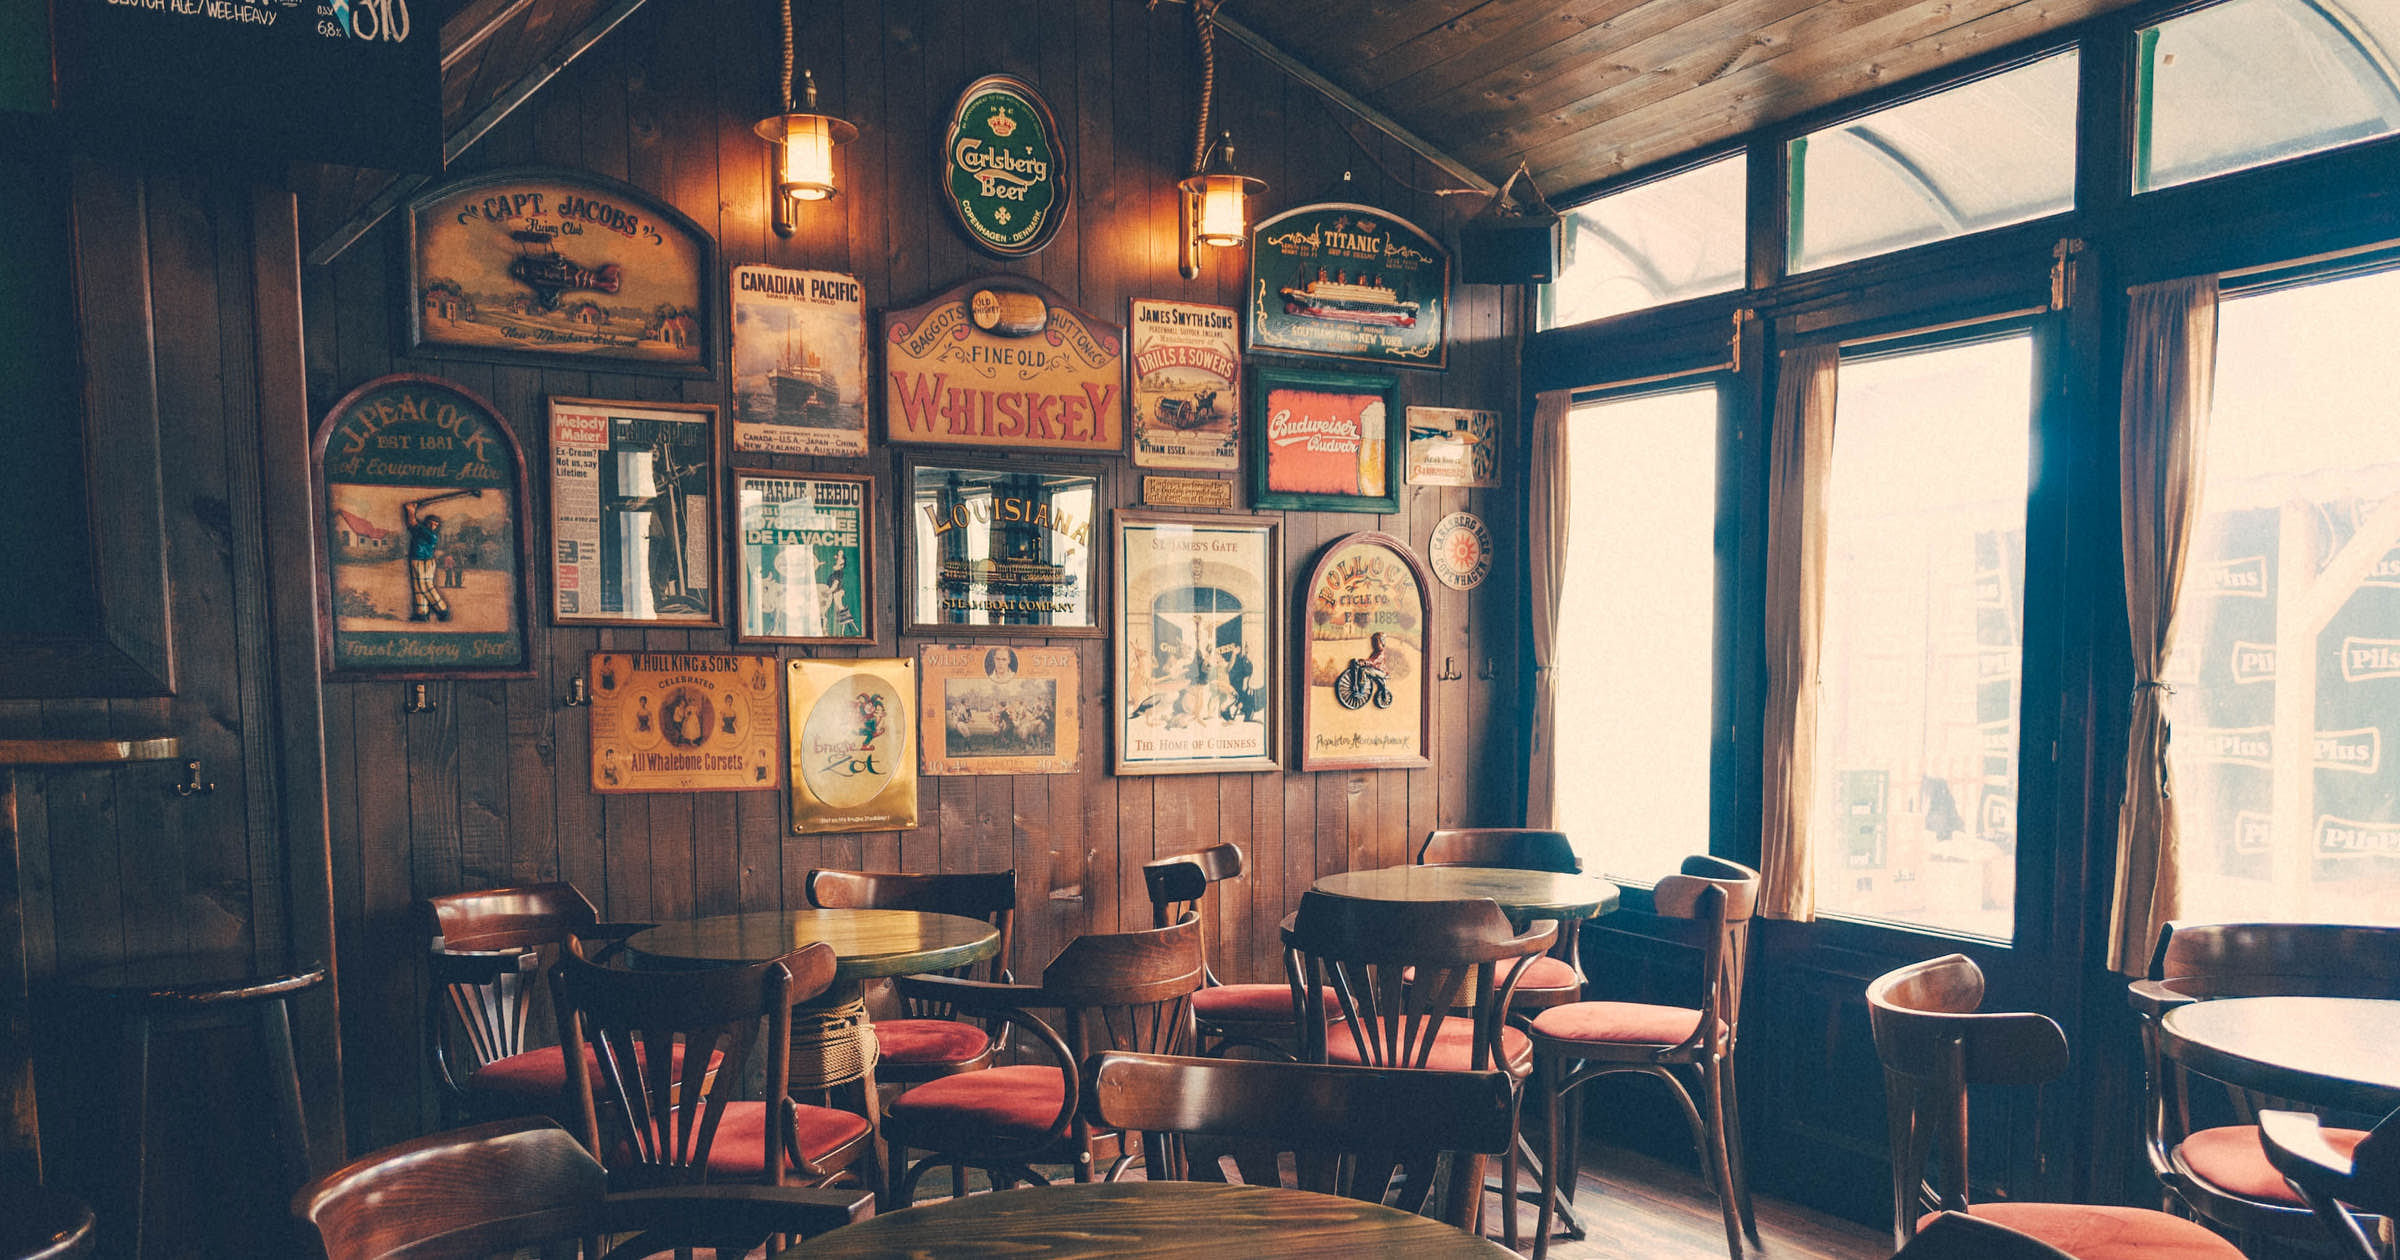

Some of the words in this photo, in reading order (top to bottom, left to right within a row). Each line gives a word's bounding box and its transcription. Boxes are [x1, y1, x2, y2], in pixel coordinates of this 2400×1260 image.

[956, 138, 1047, 182] Carlsberg
[980, 175, 1028, 201] Beer
[482, 192, 548, 223] CAPT.
[557, 195, 640, 239] JACOBS
[962, 199, 1007, 243] COPENHAGEN
[1013, 209, 1042, 242] DENMARK
[561, 221, 584, 236] Club
[1324, 230, 1382, 253] TITANIC
[740, 271, 805, 297] CANADIAN
[811, 278, 858, 302] PACIFIC
[1139, 305, 1170, 324] JAMES
[1171, 308, 1203, 328] SMYTH
[1210, 311, 1233, 330] SONS
[910, 305, 966, 356] BAGGOTS
[1359, 332, 1378, 346] NEW
[1380, 334, 1404, 348] YORK
[971, 346, 1015, 366] FINE
[1017, 350, 1046, 367] OLD
[1138, 347, 1177, 374] DRILLS
[1179, 347, 1188, 365] &
[1188, 348, 1234, 379] SOWERS
[889, 371, 1119, 443] WHISKEY
[556, 415, 606, 430] Melody
[1269, 409, 1359, 440] Budweiser
[378, 436, 411, 450] EST
[419, 436, 454, 451] 1881
[561, 428, 601, 442] Maker
[1306, 433, 1359, 453] Budvar
[743, 441, 761, 450] NEW
[766, 443, 801, 452] ZEALAND
[813, 445, 858, 456] AUSTRALIA
[1140, 444, 1165, 455] WITHAM
[1167, 445, 1186, 455] ESSEX
[1215, 447, 1235, 458] PARIS
[556, 457, 570, 468] Not
[583, 460, 598, 471] say
[556, 468, 588, 478] Lifetime
[744, 480, 807, 503] CHARLIE
[814, 483, 860, 506] HEBDO
[923, 498, 1090, 546] LOUISIANA
[748, 531, 774, 545] DE
[778, 531, 800, 546] LA
[800, 533, 858, 547] VACHE
[1434, 515, 1477, 551] CARLSBERG
[1211, 541, 1238, 553] GATE
[1435, 557, 1489, 586] COPENHAGEN
[942, 598, 1017, 611] STEAMBOAT
[1018, 600, 1075, 614] COMPANY
[1340, 593, 1372, 606] CYCLE
[1344, 611, 1370, 624] EST
[671, 655, 699, 673] KING
[709, 656, 739, 673] SONS
[1031, 654, 1070, 667] STAR
[658, 676, 716, 691] CELEBRATED
[1135, 739, 1154, 751] THE
[1159, 739, 1188, 751] HOME
[1192, 739, 1205, 750] OF
[1207, 738, 1257, 751] GUINNESS
[631, 753, 646, 772] All
[647, 752, 703, 772] Whalebone
[704, 752, 743, 771] Corsets
